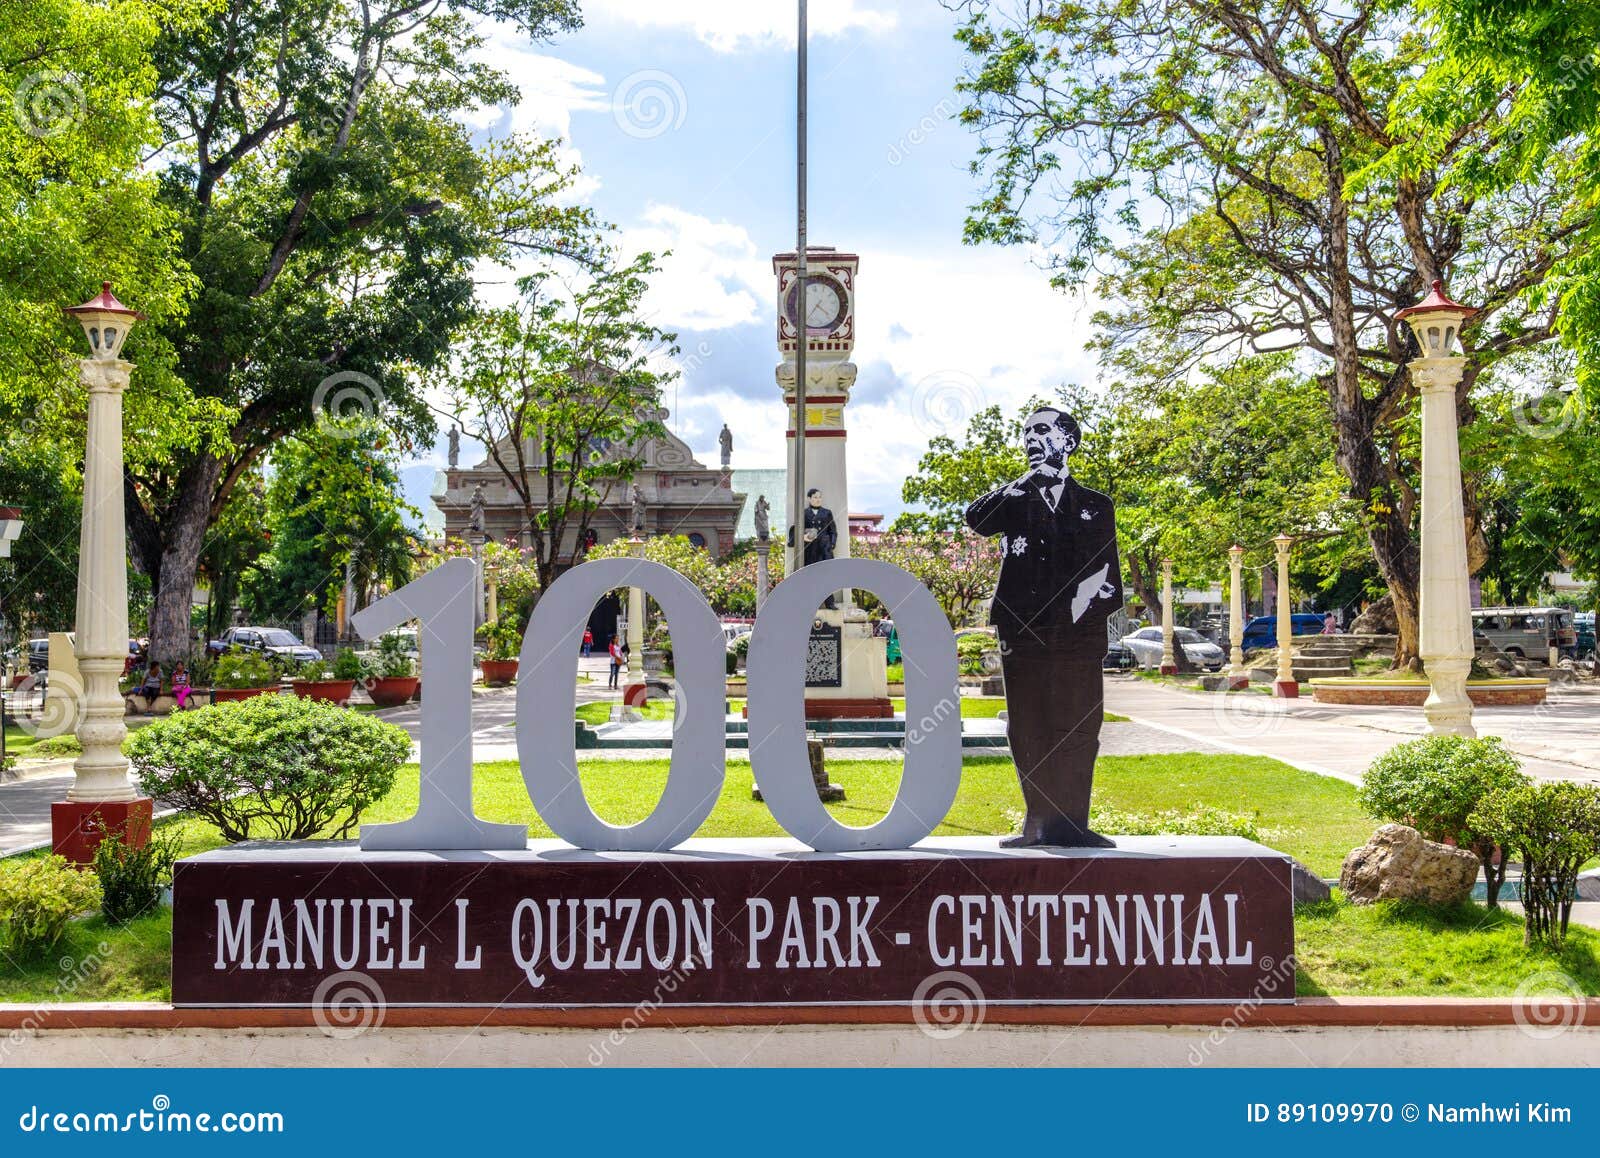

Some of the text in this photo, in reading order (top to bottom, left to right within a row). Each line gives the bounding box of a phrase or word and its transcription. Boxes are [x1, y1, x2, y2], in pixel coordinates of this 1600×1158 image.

[351, 557, 962, 851] 100
[214, 898, 425, 969] MANUEL
[454, 898, 481, 969] L
[511, 897, 714, 988] QUEZON
[746, 896, 881, 968] PARK
[927, 894, 1252, 966] CENTENNIAL
